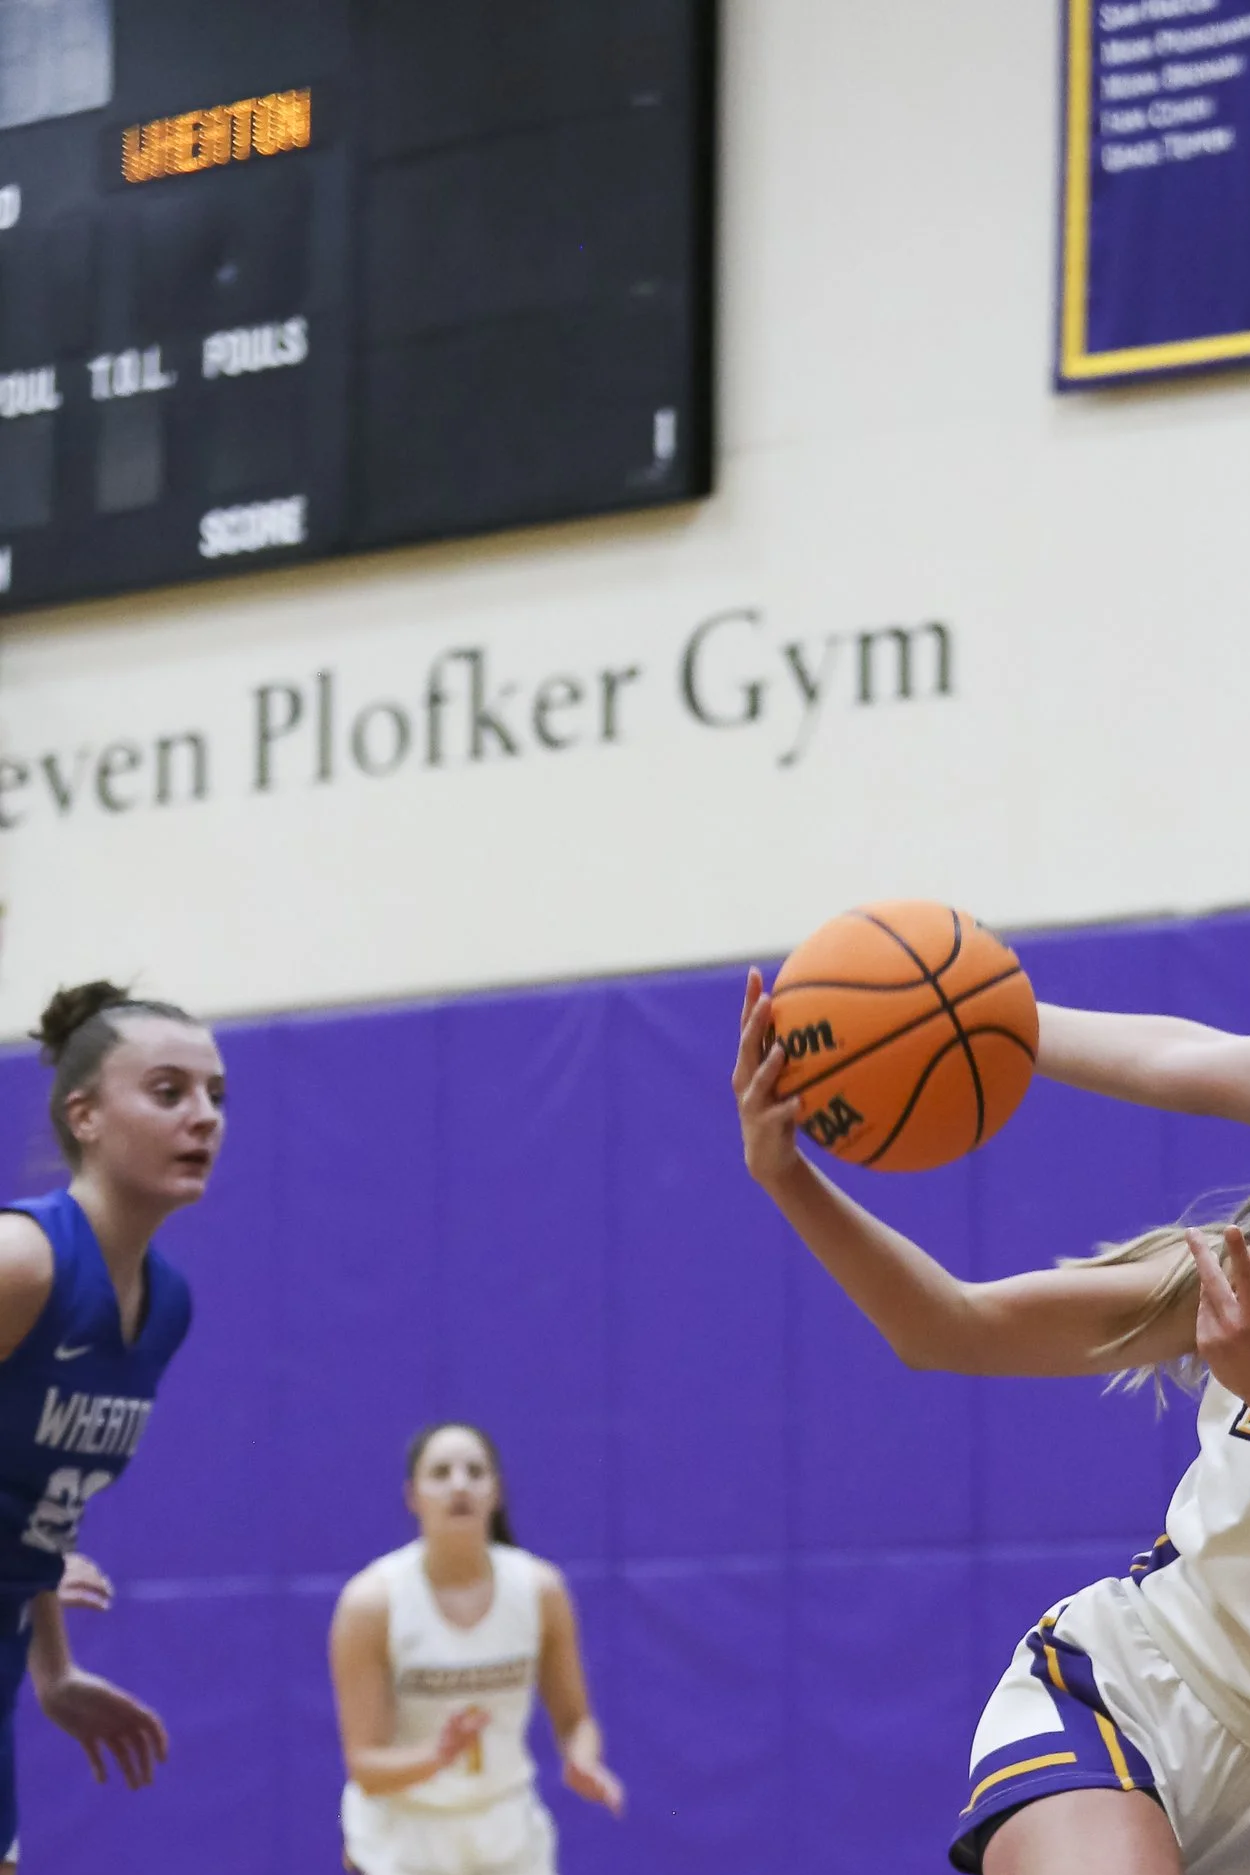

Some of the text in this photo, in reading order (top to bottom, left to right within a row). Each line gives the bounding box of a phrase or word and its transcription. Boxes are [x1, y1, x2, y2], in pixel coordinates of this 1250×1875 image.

[202, 315, 308, 379] FOULS
[198, 495, 308, 558] SCORE
[252, 643, 639, 793] Plofker
[679, 606, 954, 768] Gym
